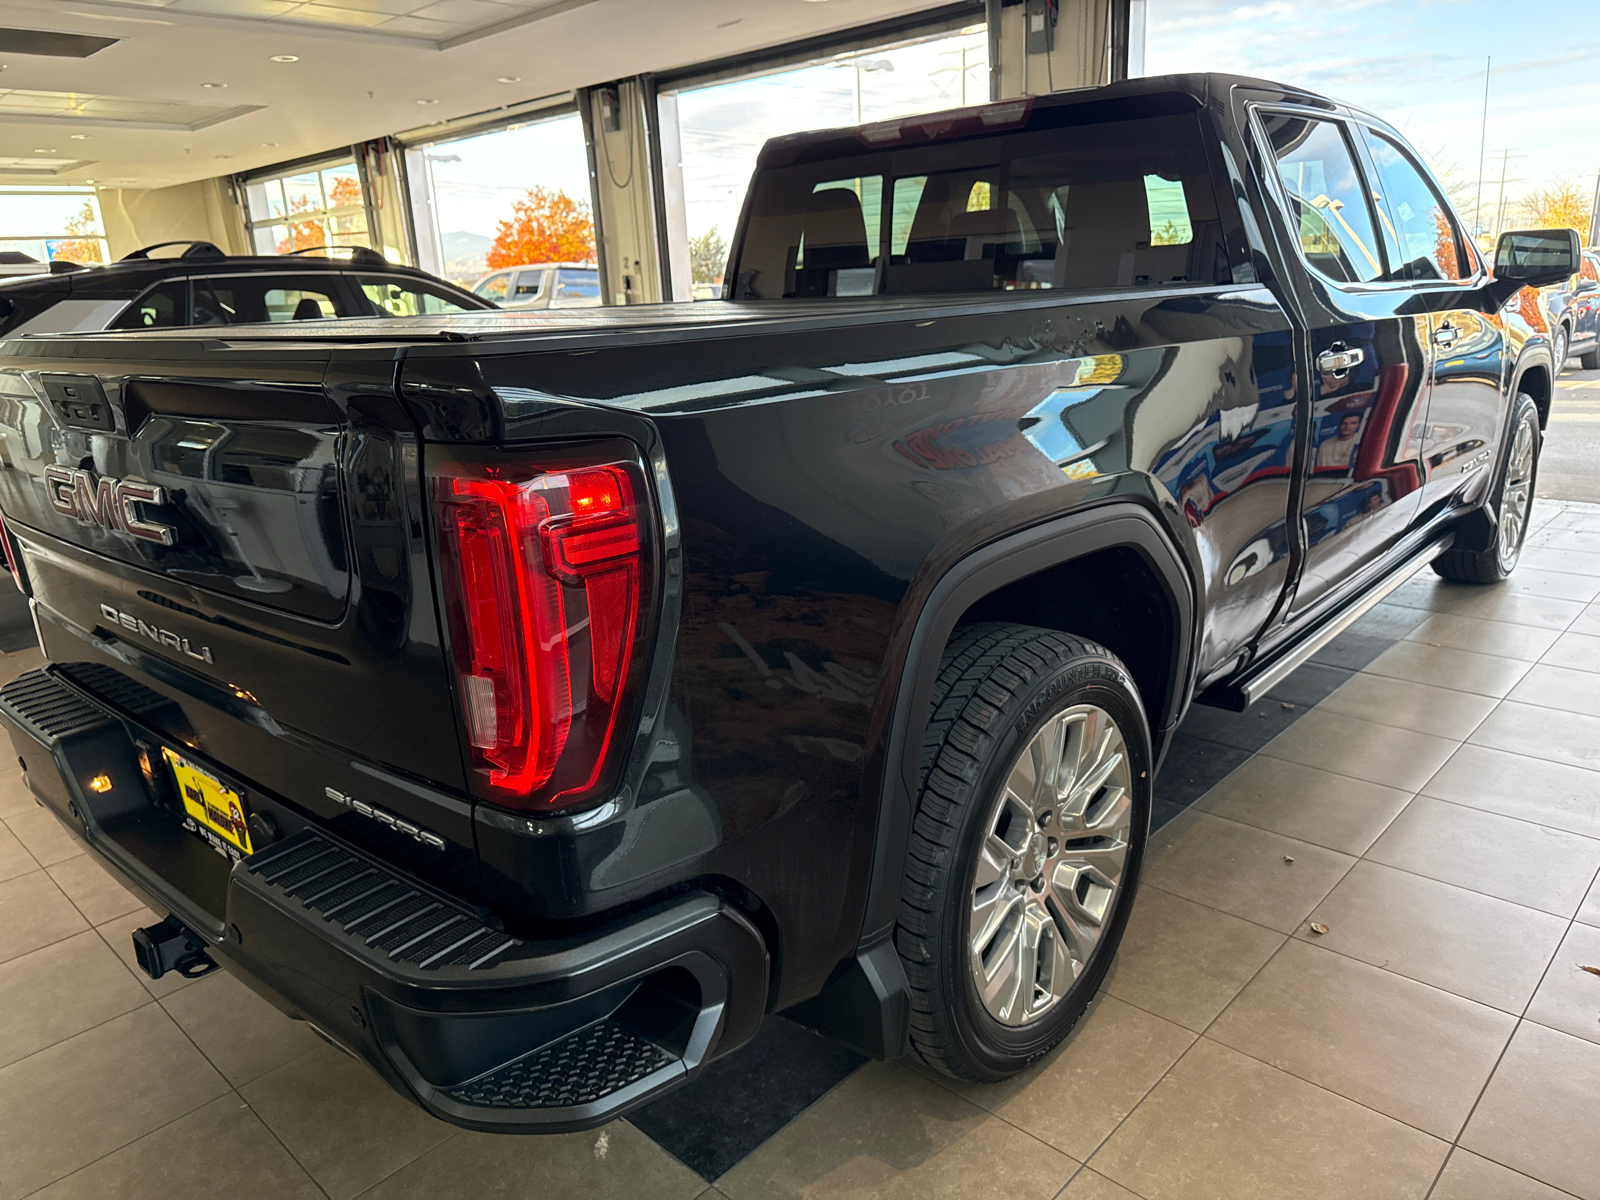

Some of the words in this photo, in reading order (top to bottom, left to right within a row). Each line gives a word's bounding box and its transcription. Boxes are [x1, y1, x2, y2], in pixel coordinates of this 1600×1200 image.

[44, 463, 175, 546] GMC
[100, 603, 214, 665] DENALI
[1014, 664, 1101, 738] ENCOUNTER
[325, 786, 446, 851] SIERRA
